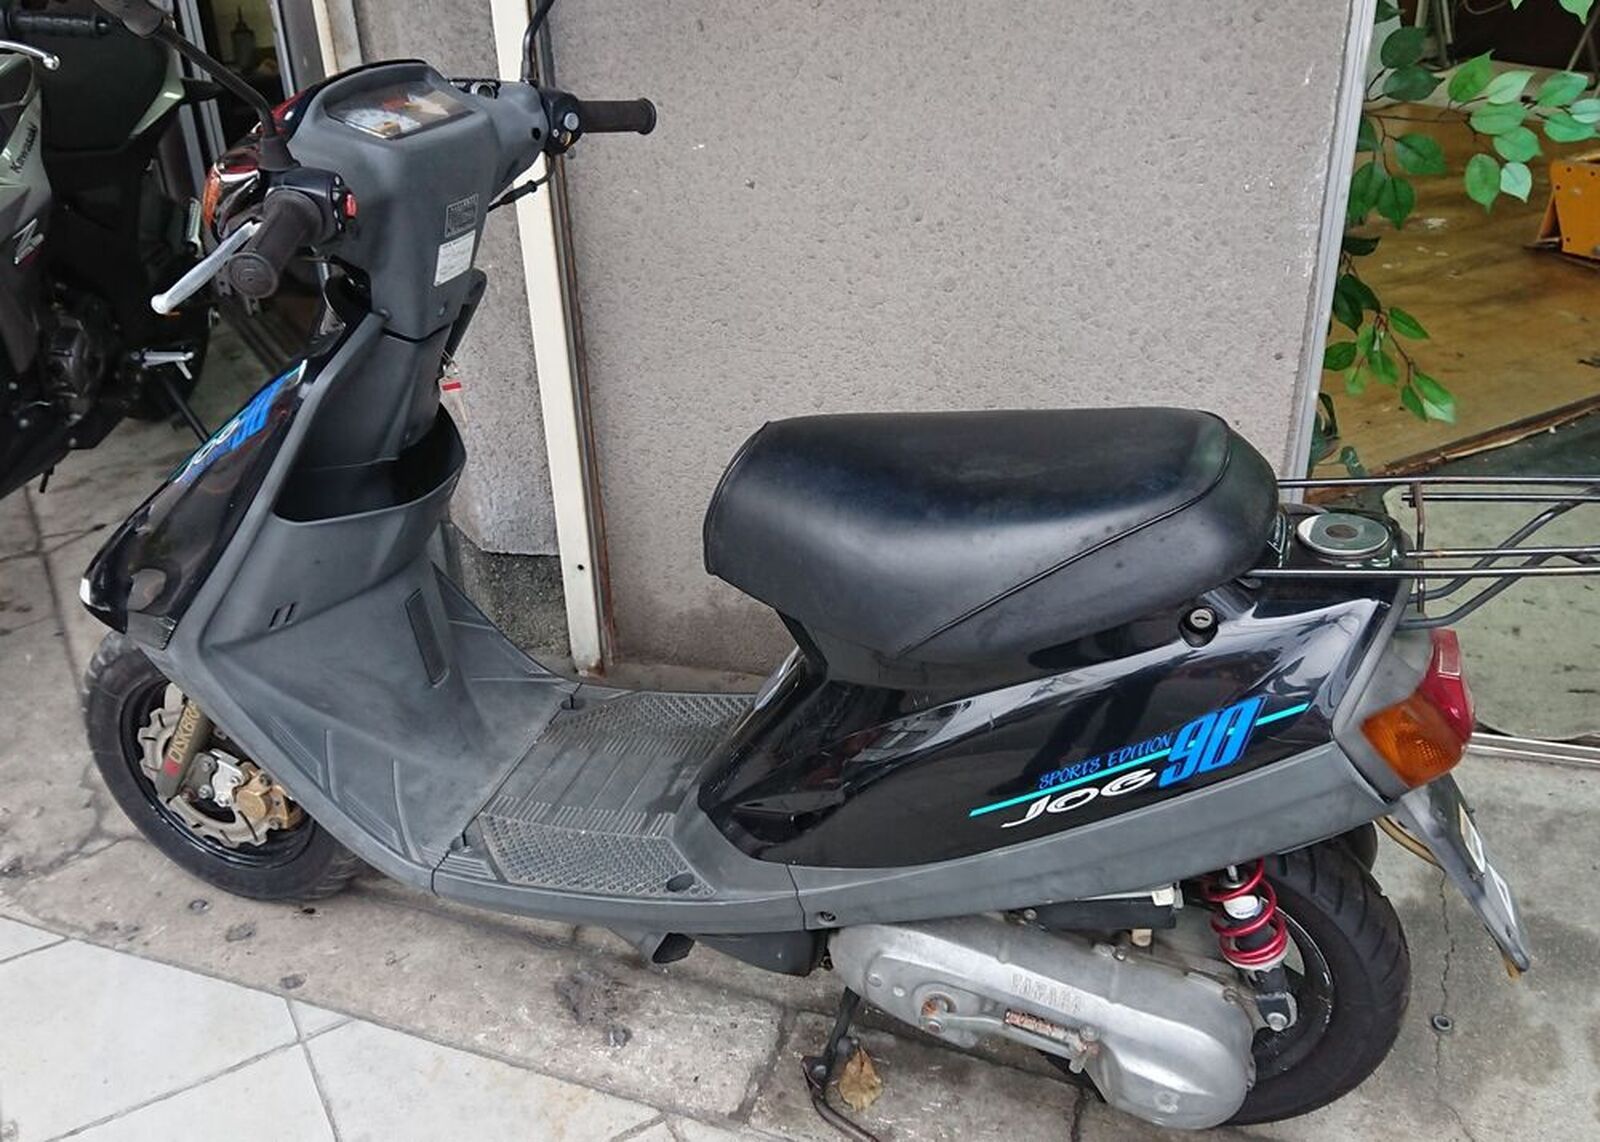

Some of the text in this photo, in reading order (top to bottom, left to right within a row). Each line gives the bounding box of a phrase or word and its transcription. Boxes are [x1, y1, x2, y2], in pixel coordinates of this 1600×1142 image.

[10, 121, 38, 174] Kawasaki
[1000, 696, 1267, 828] JOG 90
[1038, 731, 1174, 790] SPORTS EDITION
